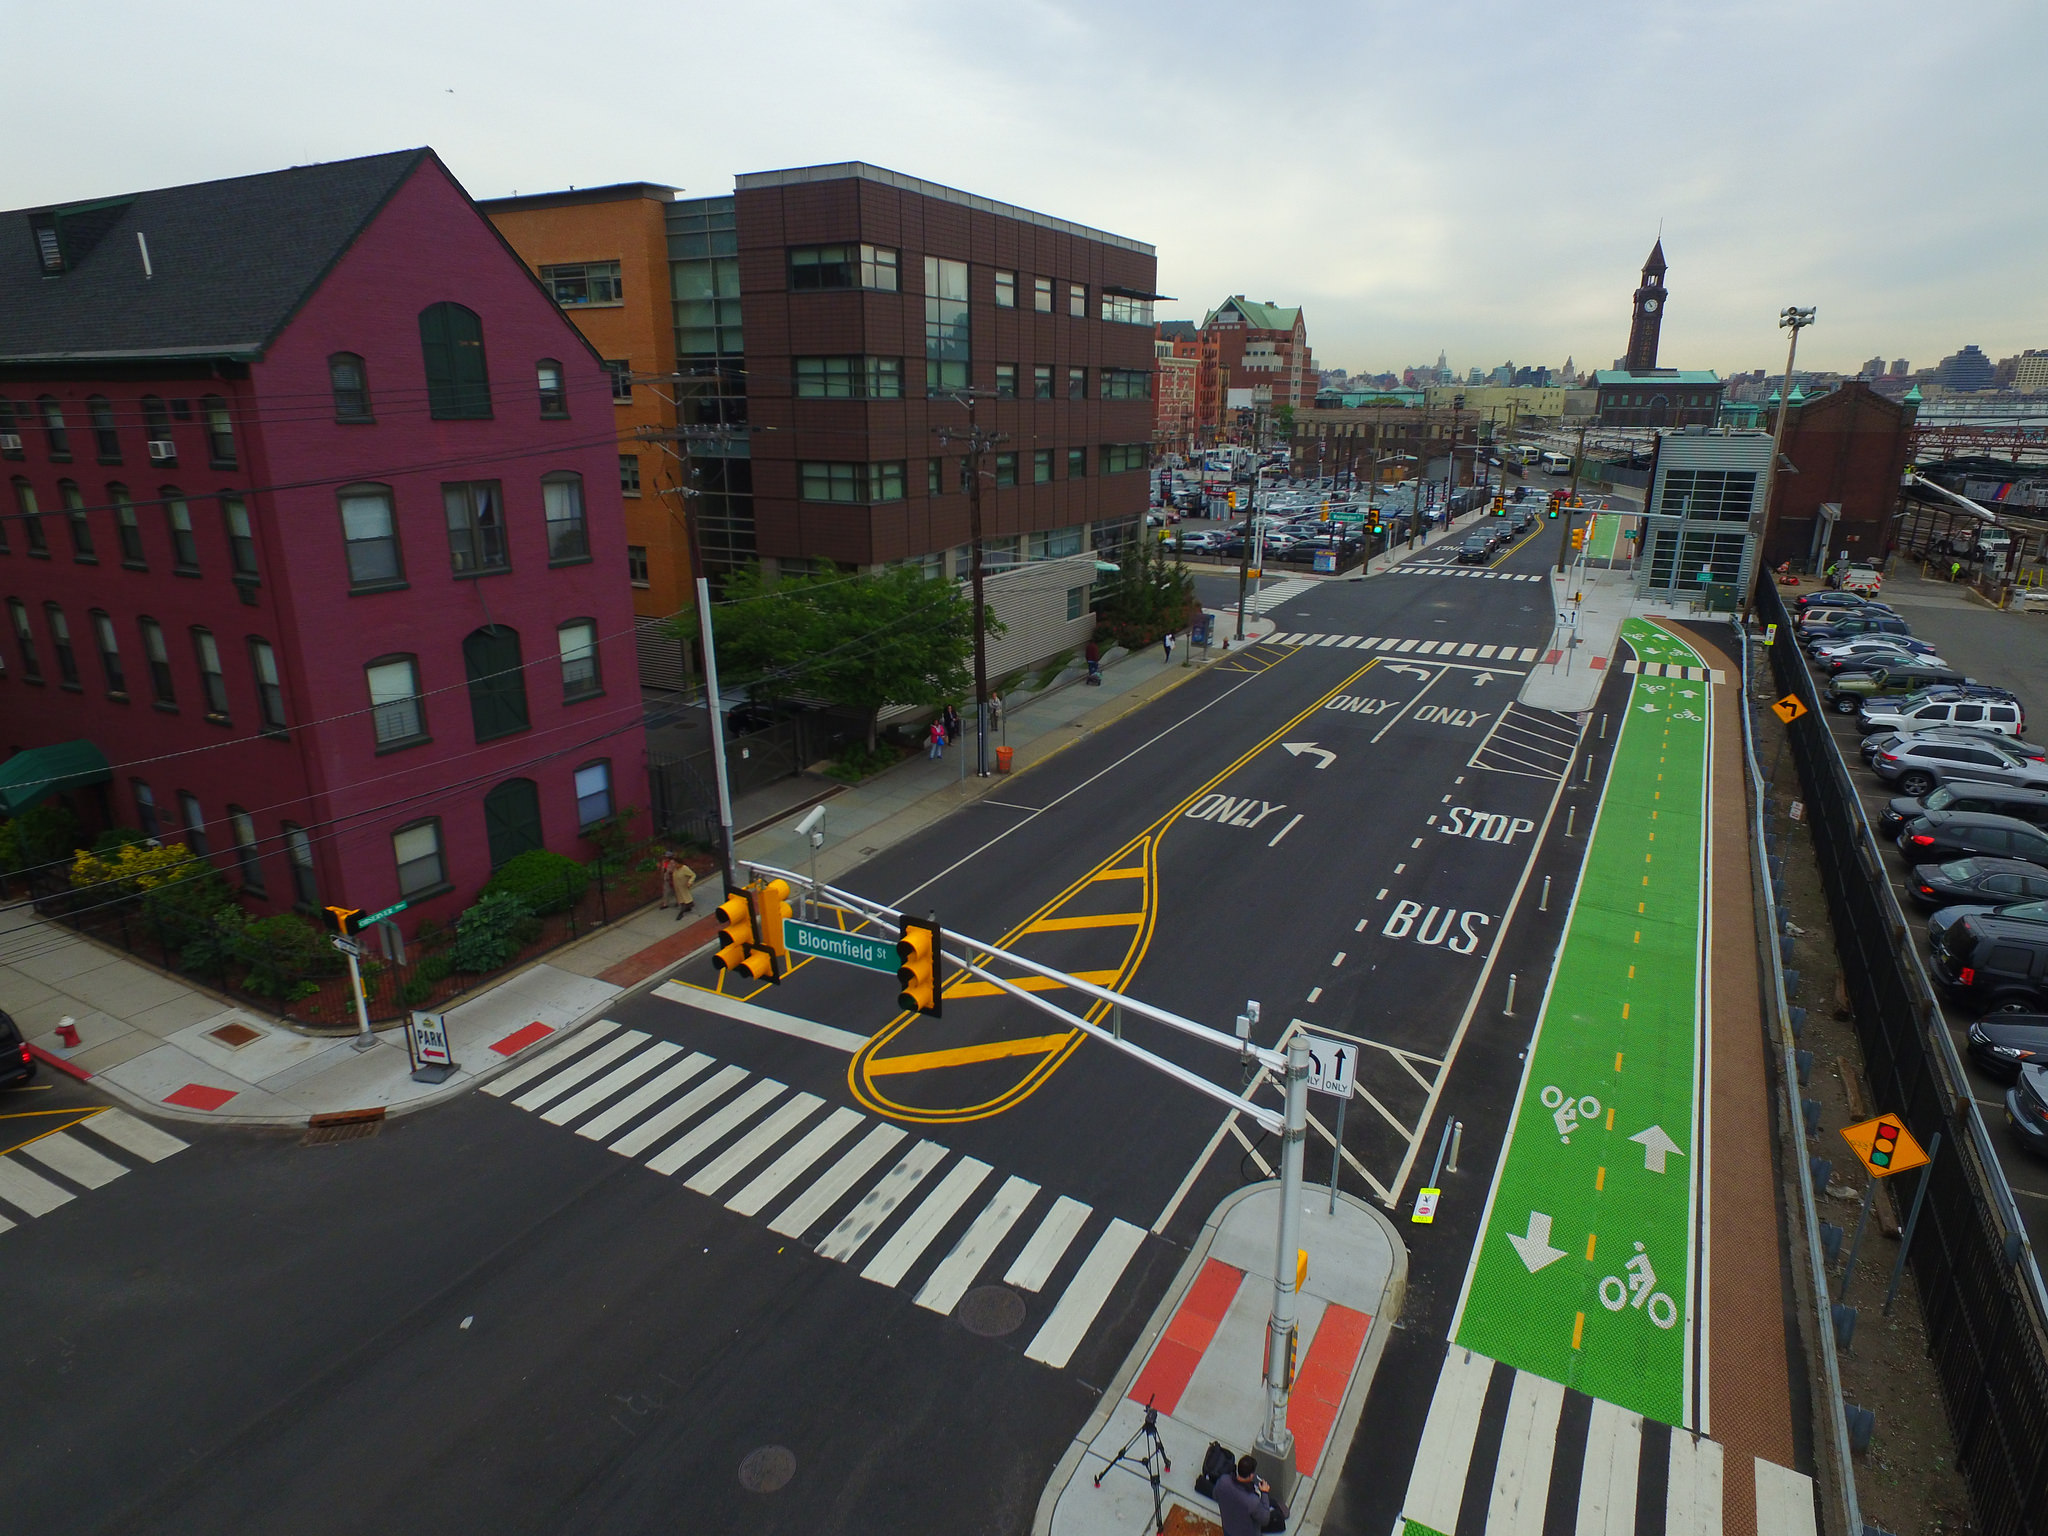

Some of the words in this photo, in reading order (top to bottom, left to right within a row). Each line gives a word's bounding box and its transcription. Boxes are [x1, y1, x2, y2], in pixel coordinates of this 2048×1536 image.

[1325, 694, 1400, 714] ONLY
[1413, 705, 1491, 727] ONLY
[1185, 793, 1287, 828] ONLY
[1441, 807, 1535, 844] STOP
[1382, 900, 1489, 954] BUS
[798, 929, 873, 961] Bloomfield
[876, 947, 887, 960] St
[417, 1029, 445, 1047] PARK
[1326, 1080, 1348, 1092] ONLY
